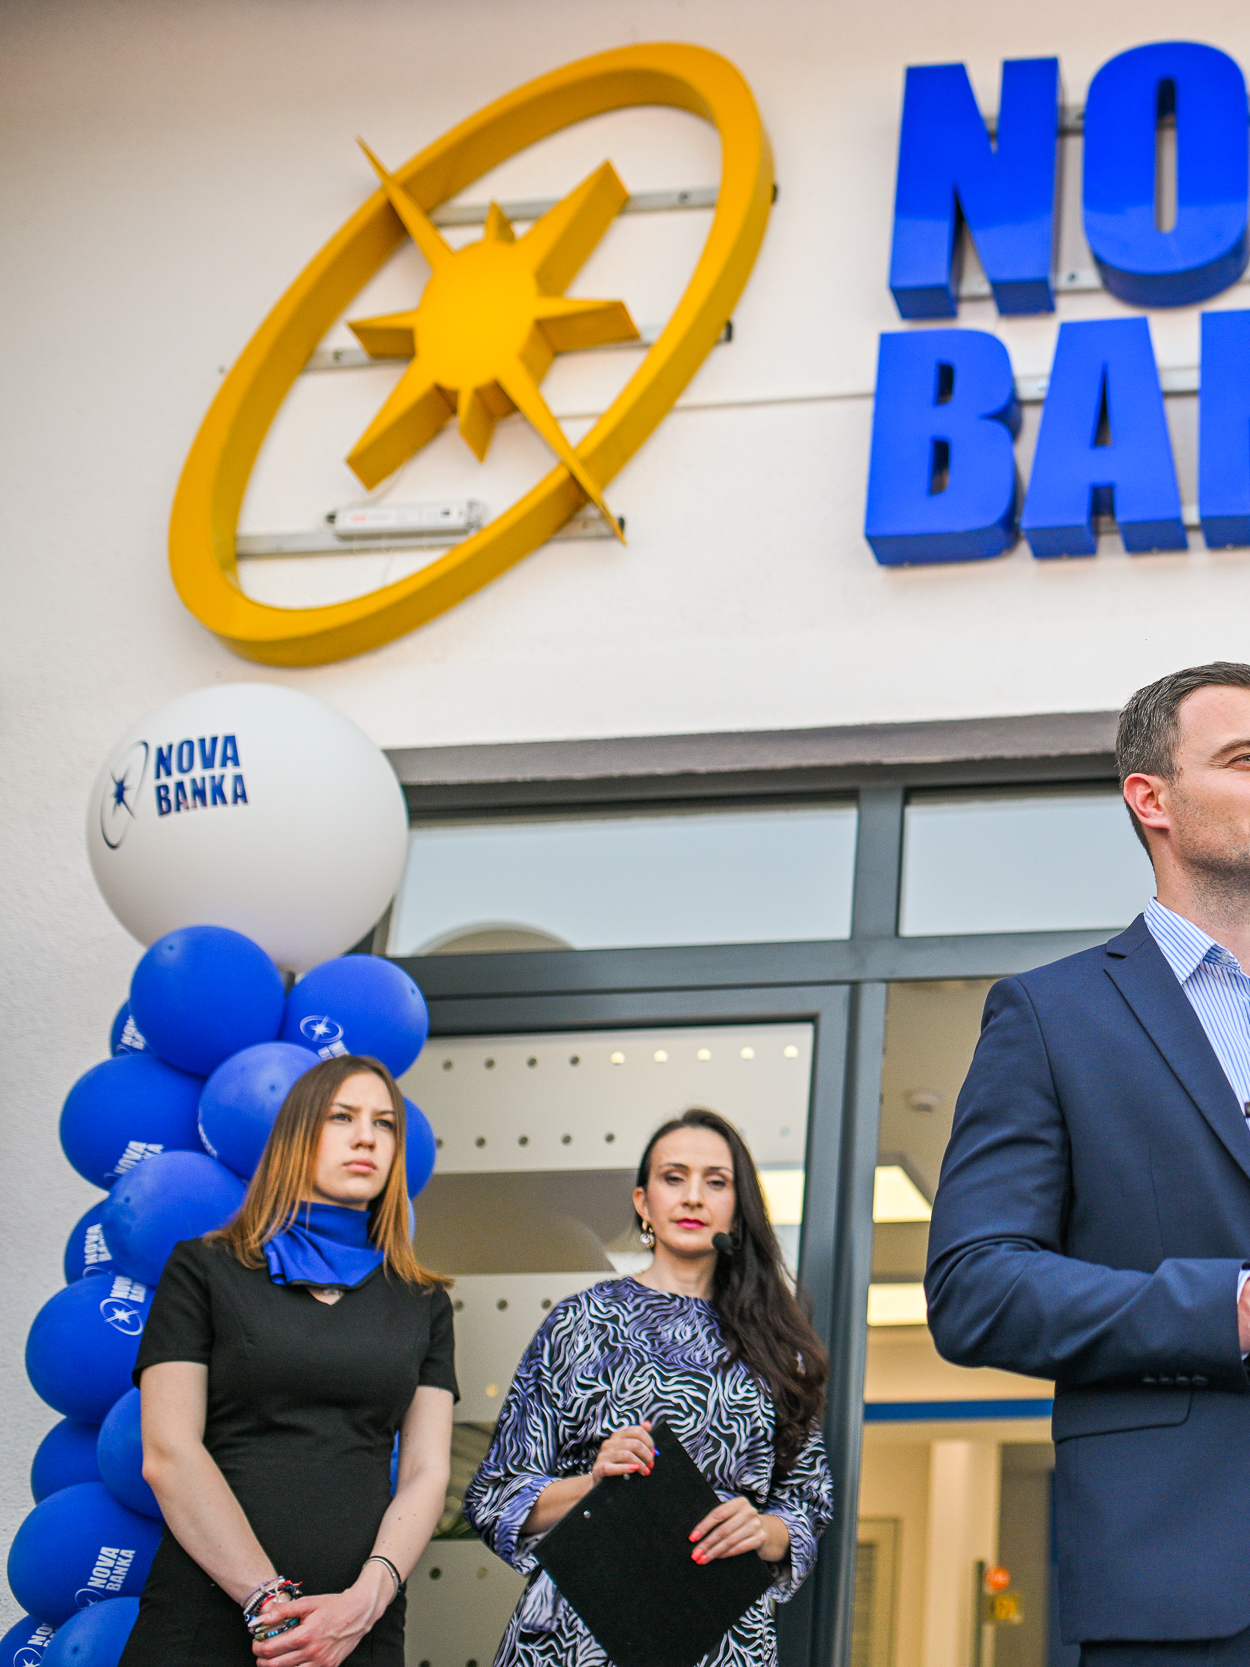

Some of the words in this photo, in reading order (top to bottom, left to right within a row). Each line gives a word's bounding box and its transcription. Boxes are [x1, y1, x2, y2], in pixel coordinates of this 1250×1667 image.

[154, 735, 240, 780] NOVA
[155, 774, 248, 817] BANKA
[84, 1223, 103, 1266] NOVA
[87, 1546, 120, 1589] NOVA
[105, 1549, 136, 1591] BANKA
